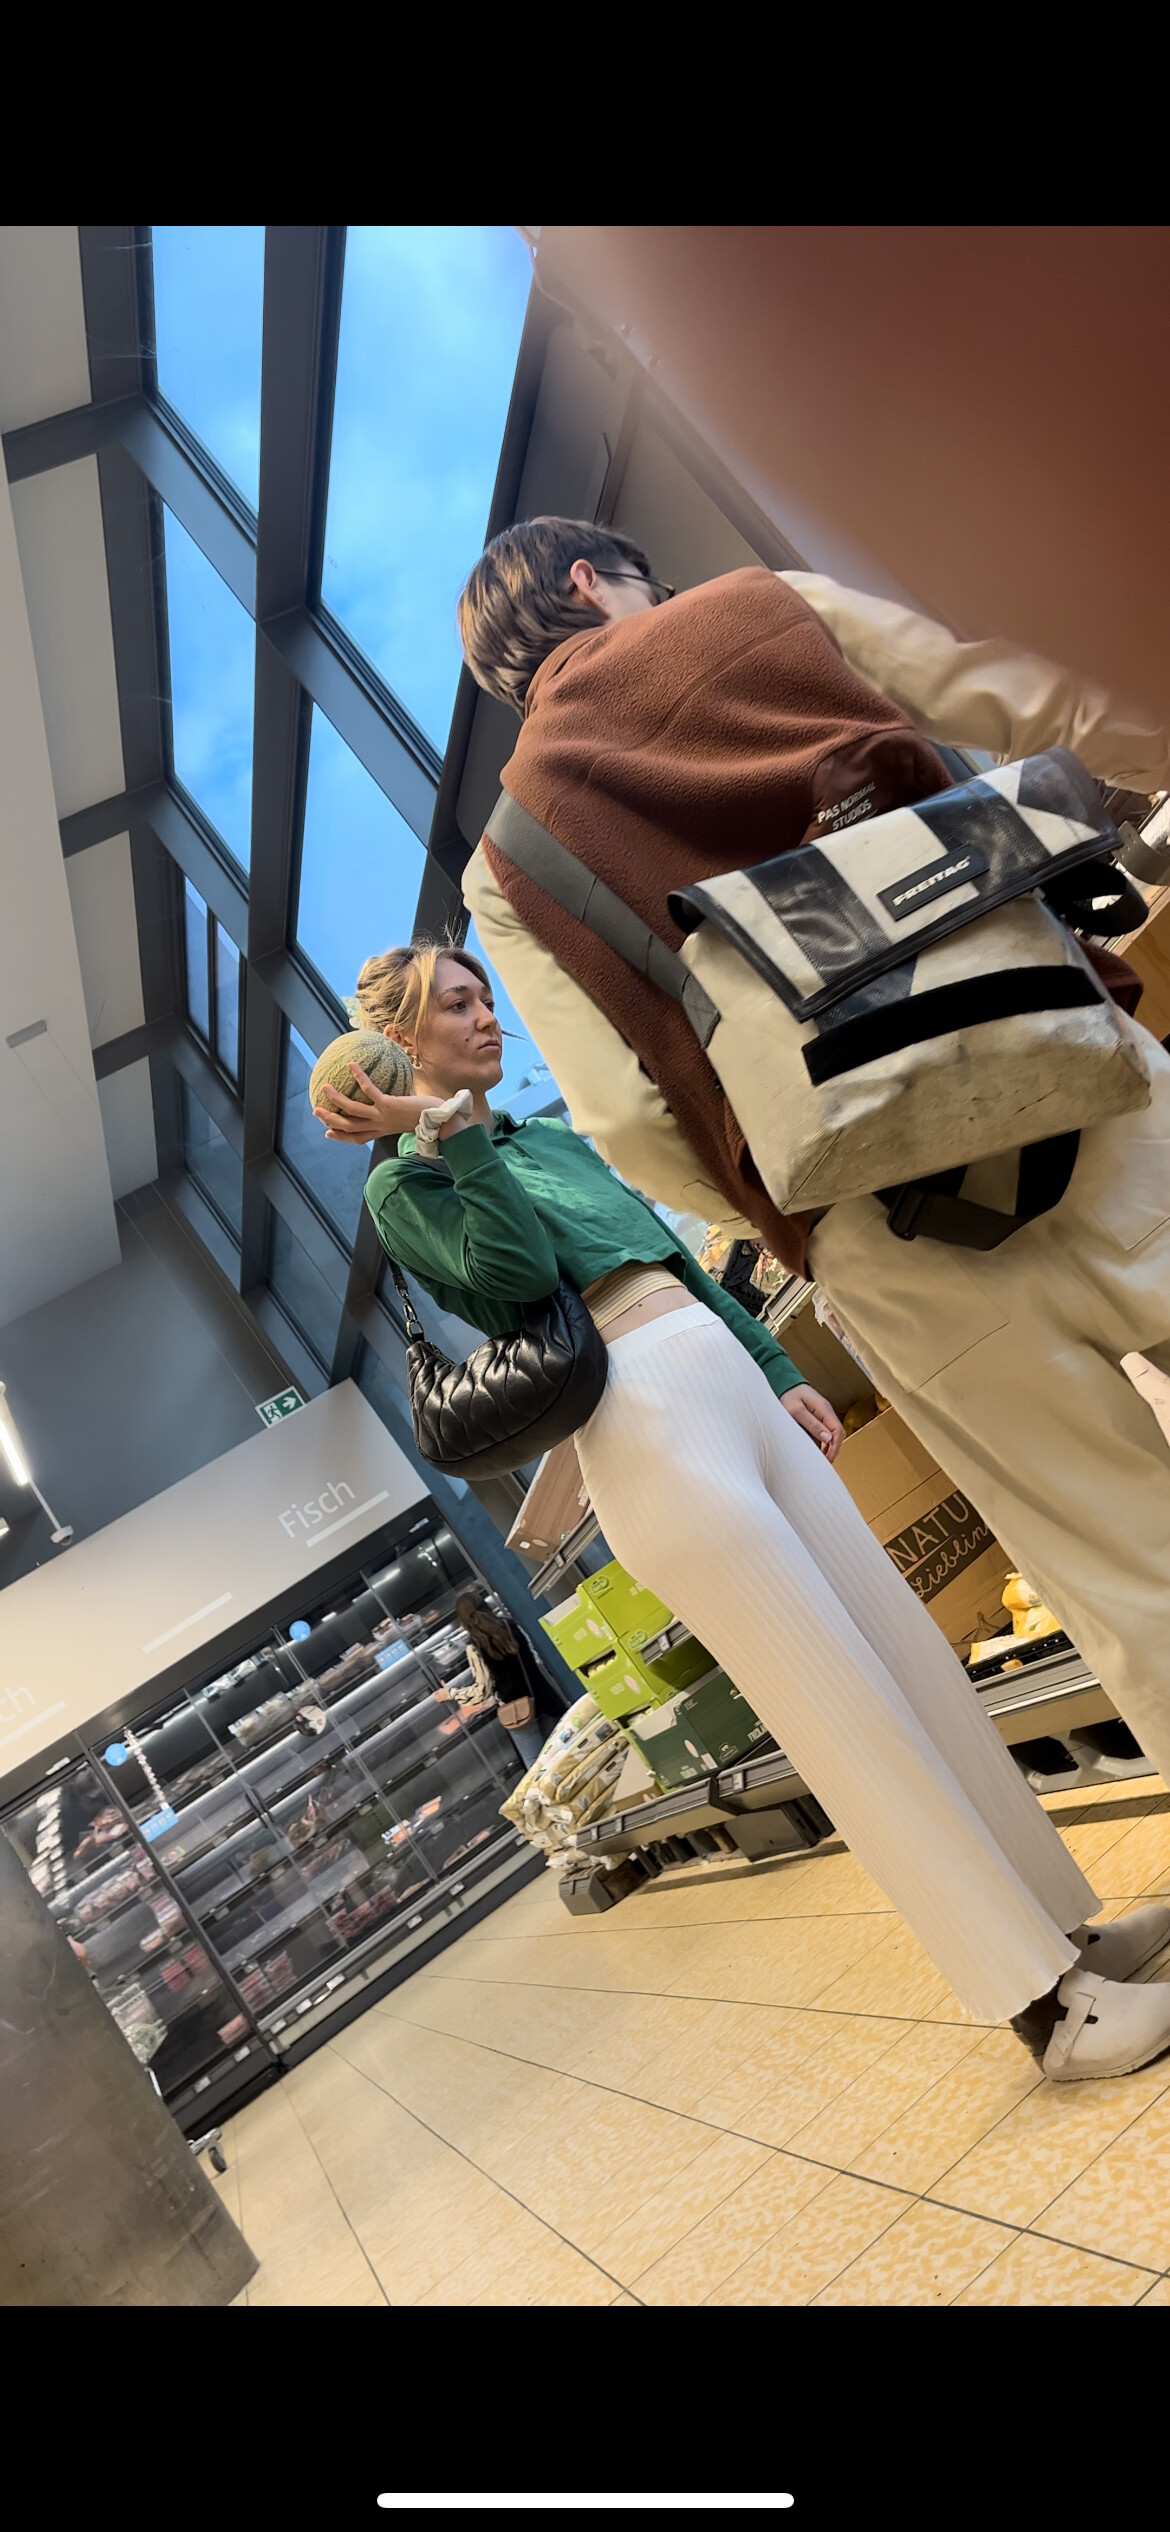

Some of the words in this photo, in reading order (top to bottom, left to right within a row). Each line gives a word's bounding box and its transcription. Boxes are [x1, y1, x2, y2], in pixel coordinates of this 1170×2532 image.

[817, 804, 840, 824] PAS
[839, 780, 876, 812] NORMAL
[832, 798, 873, 831] STUDIOS
[892, 855, 971, 907] FREITAG
[278, 1481, 356, 1538] Fisch
[885, 1493, 969, 1571] NATU
[910, 1524, 989, 1598] Lieblin
